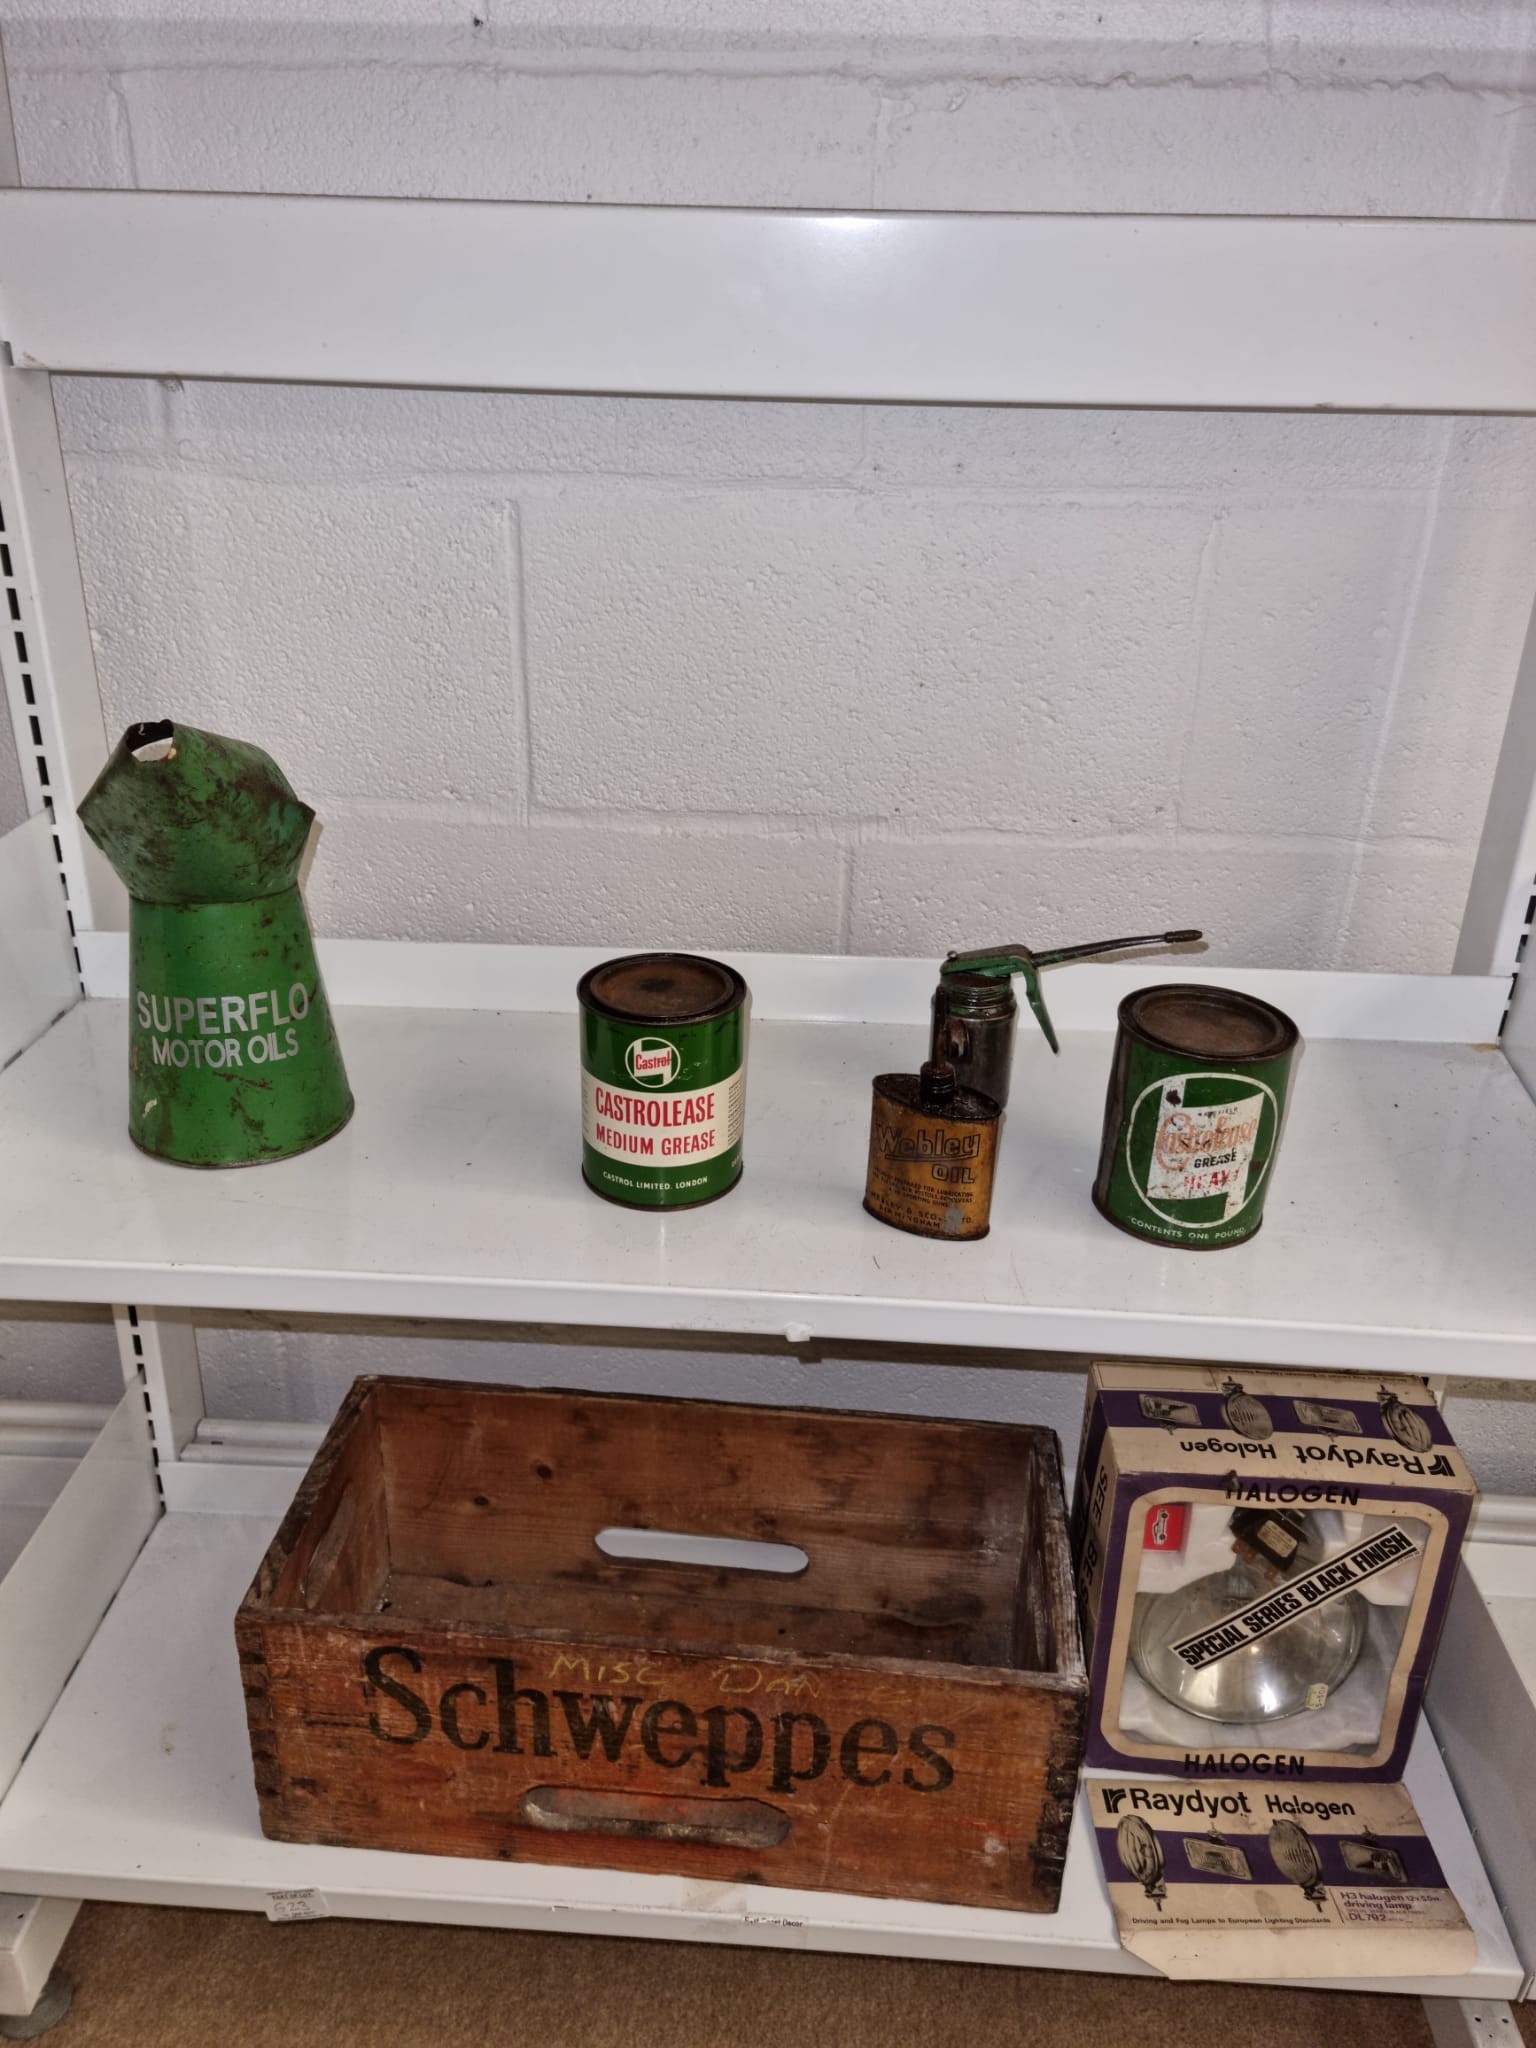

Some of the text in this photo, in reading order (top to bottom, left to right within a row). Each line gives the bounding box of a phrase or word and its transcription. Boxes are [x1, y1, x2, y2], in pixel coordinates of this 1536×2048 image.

[137, 983, 308, 1034] SUPERFLO
[152, 1028, 299, 1068] MOTOR OILS
[635, 1050, 672, 1071] Castrol
[595, 1087, 715, 1127] CASTROLEASE
[596, 1123, 716, 1156] MEDIUM GREASE
[878, 1124, 980, 1158] Webley
[1194, 1151, 1237, 1168] GREASE
[603, 1171, 634, 1187] CASTROL
[675, 1176, 708, 1189] LONDON
[931, 1163, 976, 1184] OIL
[1130, 1217, 1183, 1238] CONTENTS
[1188, 1231, 1209, 1239] ONE
[1180, 1440, 1277, 1459] Halogen
[1296, 1444, 1428, 1476] Raydyot
[1225, 1480, 1360, 1506] HALOGEN
[1178, 1531, 1413, 1666] SPECIAL SERIES BLACK FINISH
[363, 1645, 956, 1794] Schweppes
[1184, 1752, 1305, 1776] HALOGEN
[1131, 1787, 1252, 1818] Raydyot
[1265, 1795, 1356, 1820] Halogen
[1340, 1891, 1358, 1900] H3
[1359, 1892, 1405, 1903] halogen
[1343, 1900, 1384, 1910] driving
[1385, 1902, 1413, 1911] lamp
[1132, 1917, 1158, 1925] Driving
[1175, 1917, 1190, 1926] Fog
[1191, 1917, 1216, 1925] Lamps
[1227, 1917, 1263, 1925] European
